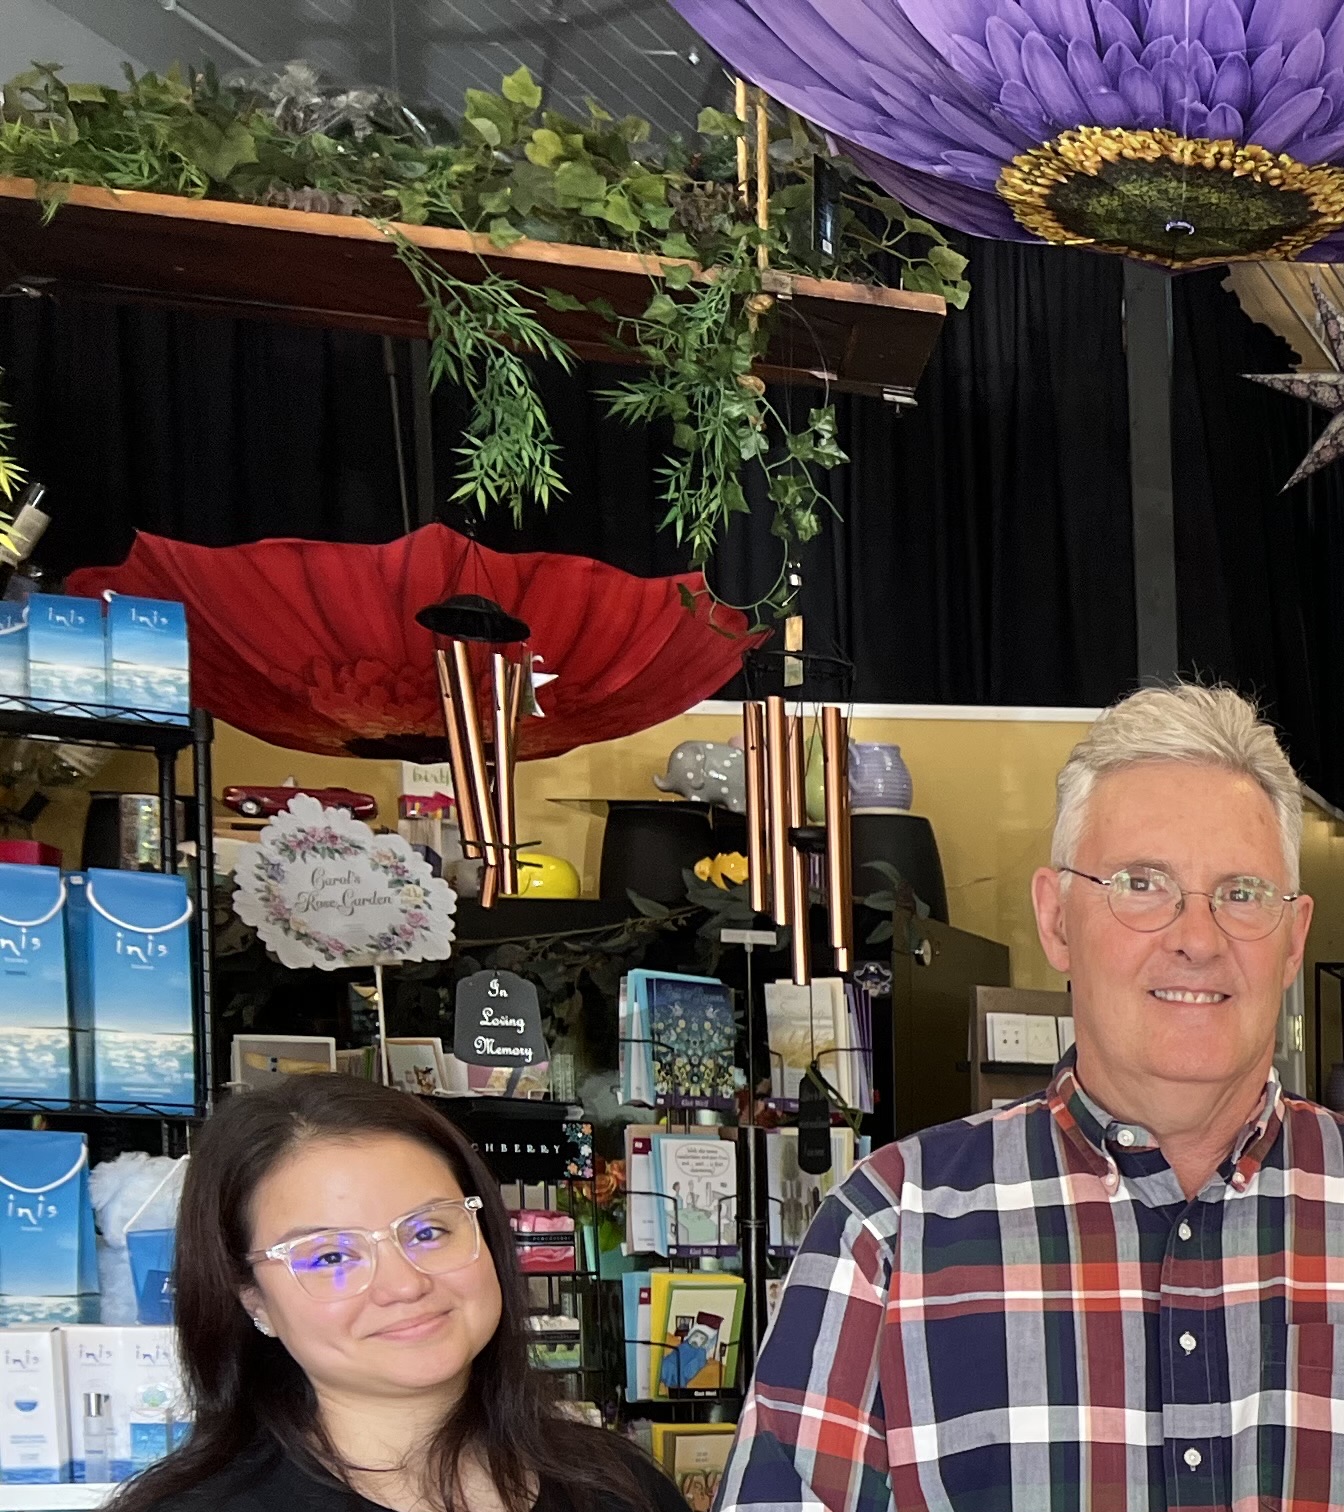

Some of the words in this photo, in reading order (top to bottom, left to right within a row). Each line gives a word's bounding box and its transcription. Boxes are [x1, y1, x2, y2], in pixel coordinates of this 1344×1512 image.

[311, 867, 362, 887] Carol's
[295, 891, 336, 915] Rose
[335, 891, 392, 916] Garden
[115, 931, 169, 963] inis
[487, 978, 509, 998] In
[479, 1007, 526, 1034] Loving
[473, 1036, 533, 1062] Memory
[6, 1194, 59, 1226] inis
